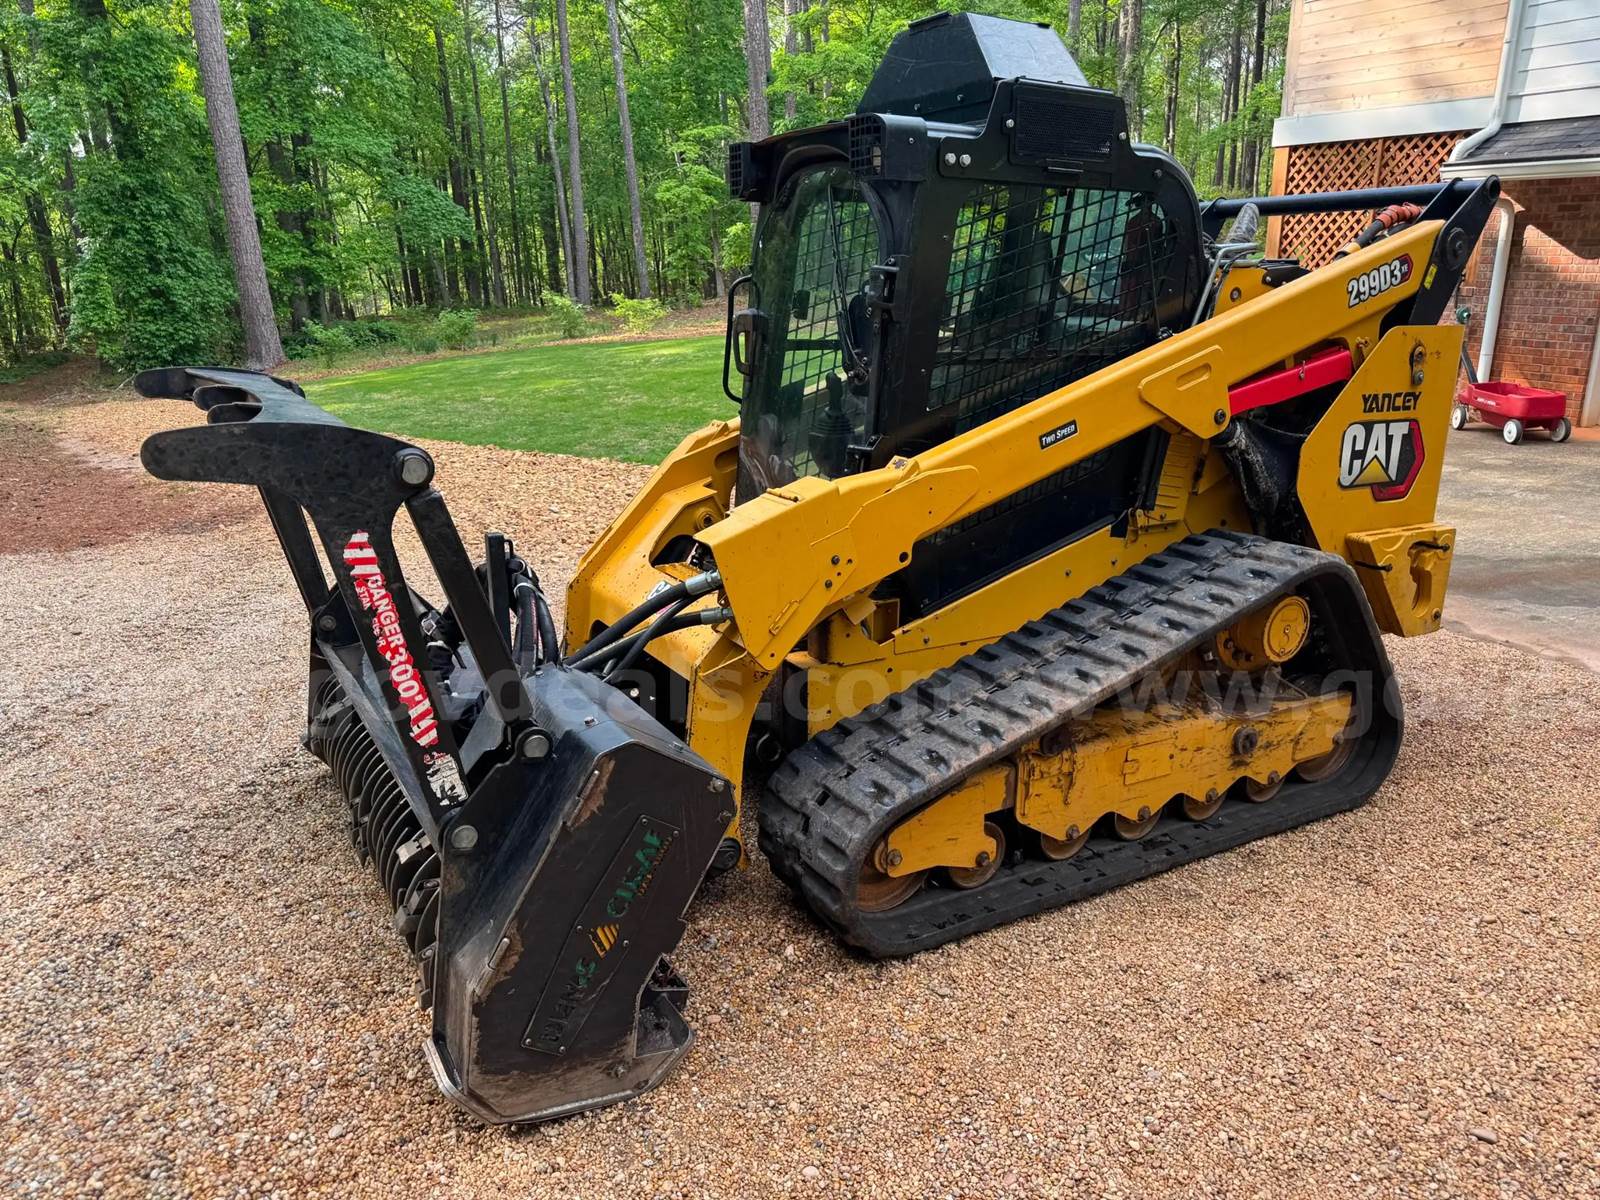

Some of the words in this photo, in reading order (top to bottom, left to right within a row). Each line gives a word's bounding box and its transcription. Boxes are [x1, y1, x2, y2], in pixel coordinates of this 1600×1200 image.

[1347, 259, 1402, 308] 299D3
[1362, 391, 1422, 413] YANCEY
[1339, 420, 1410, 487] CAT
[367, 574, 406, 649] DANGER
[371, 617, 387, 647] CLER
